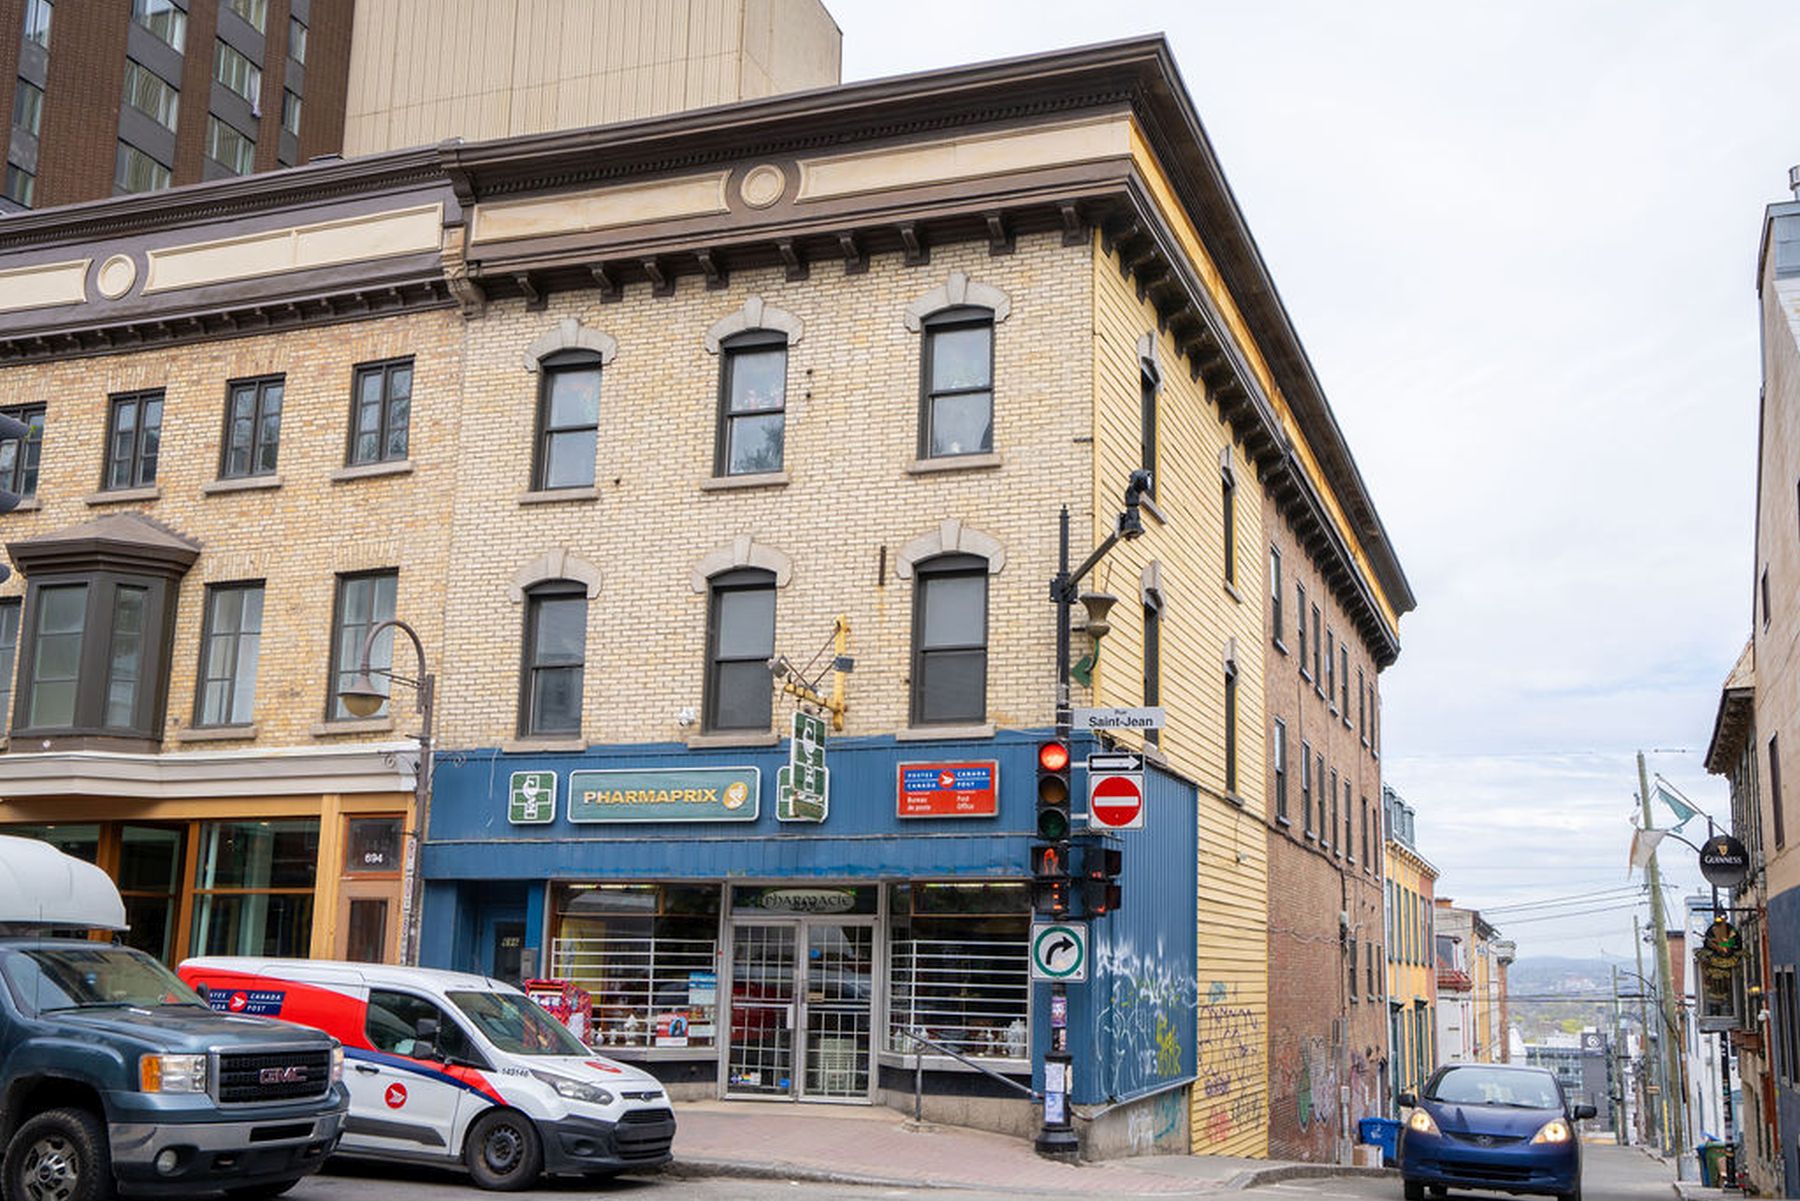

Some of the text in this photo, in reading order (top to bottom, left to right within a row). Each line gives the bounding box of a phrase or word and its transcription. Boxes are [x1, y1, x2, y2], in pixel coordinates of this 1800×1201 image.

[1088, 716, 1154, 728] Saint-Jean
[956, 770, 987, 778] CANADA
[907, 782, 937, 790] CANADA
[583, 788, 719, 805] PHARMAPRIX
[364, 852, 383, 864] 694
[1704, 854, 1743, 865] GUINNESS
[209, 991, 227, 999] STES
[249, 992, 282, 1001] CANADA
[246, 1004, 267, 1012] POST
[259, 1066, 308, 1084] GMC
